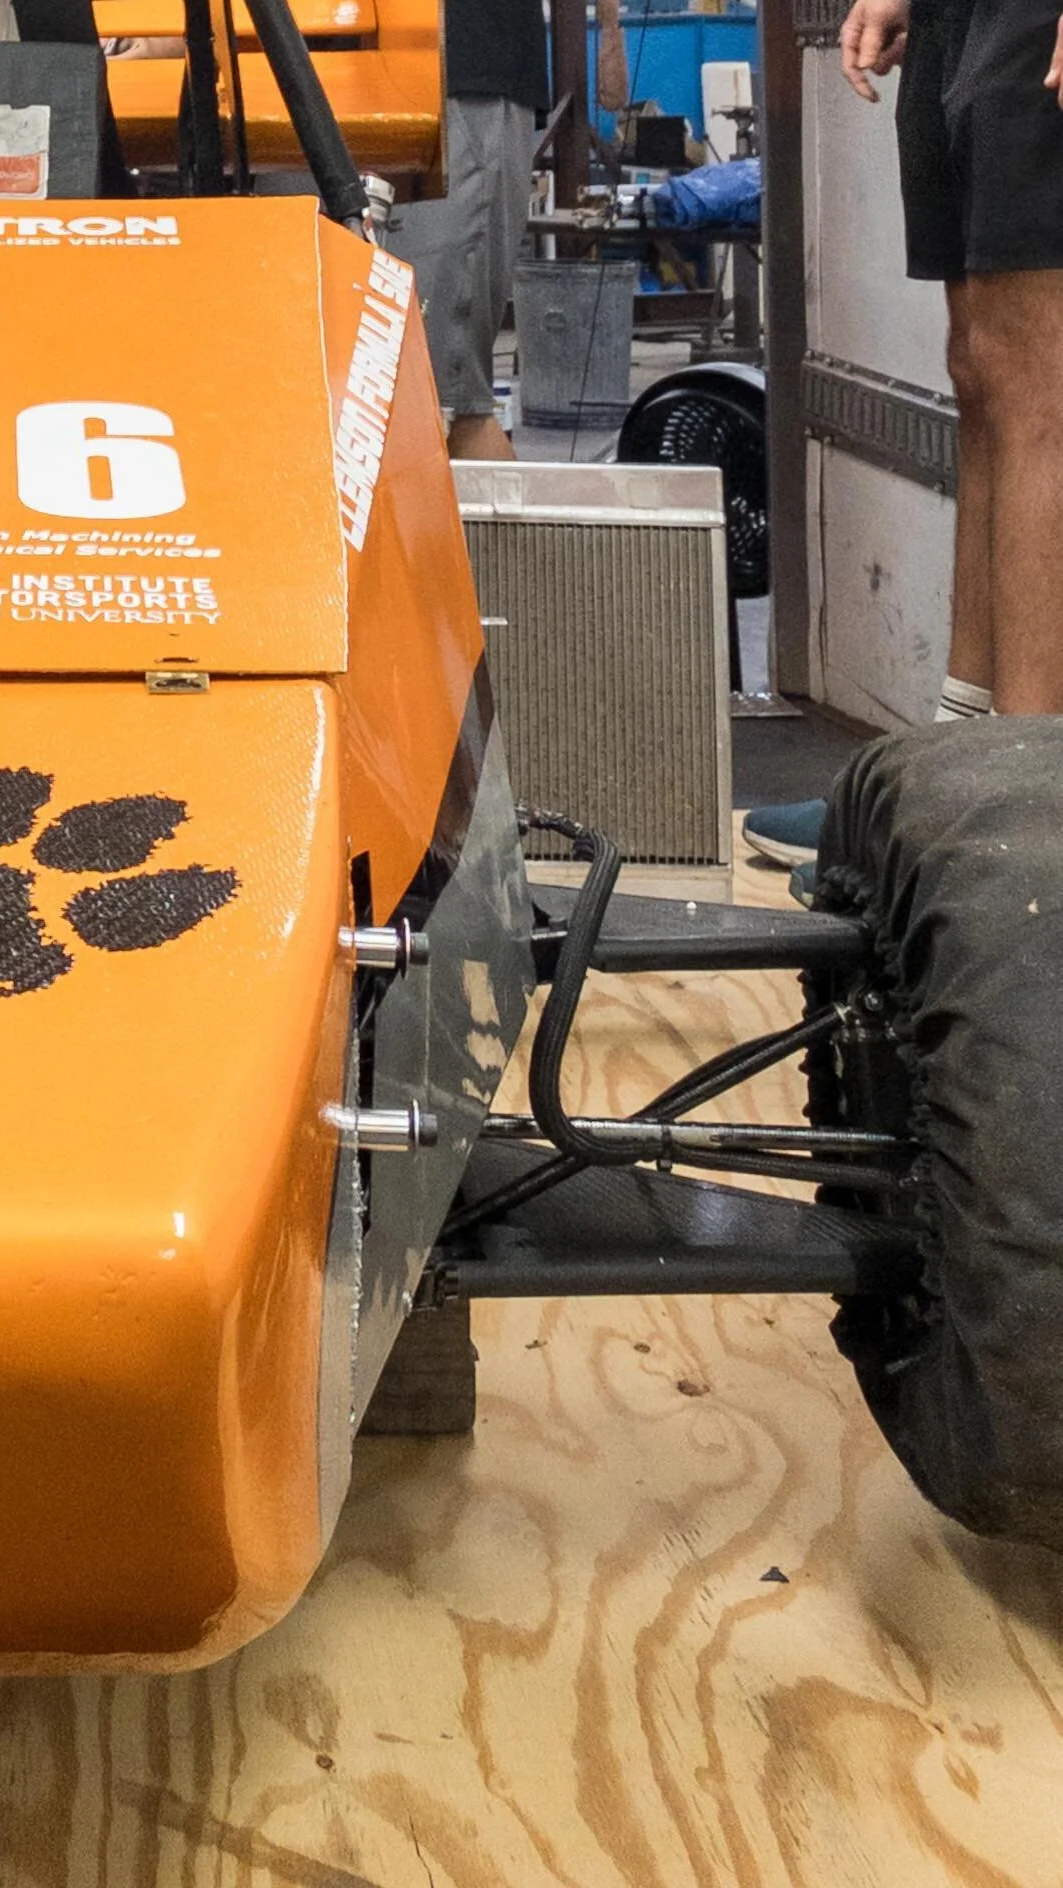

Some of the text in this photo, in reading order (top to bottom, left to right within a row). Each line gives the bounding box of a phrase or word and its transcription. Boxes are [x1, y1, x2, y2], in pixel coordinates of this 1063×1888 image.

[68, 236, 181, 246] VEHICLES
[335, 247, 413, 553] CLEMSON FORMULA SAE
[21, 529, 197, 546] Machining
[75, 543, 222, 558] Services
[12, 573, 214, 594] INSTITUTE
[11, 608, 222, 625] UNIVERSITY
